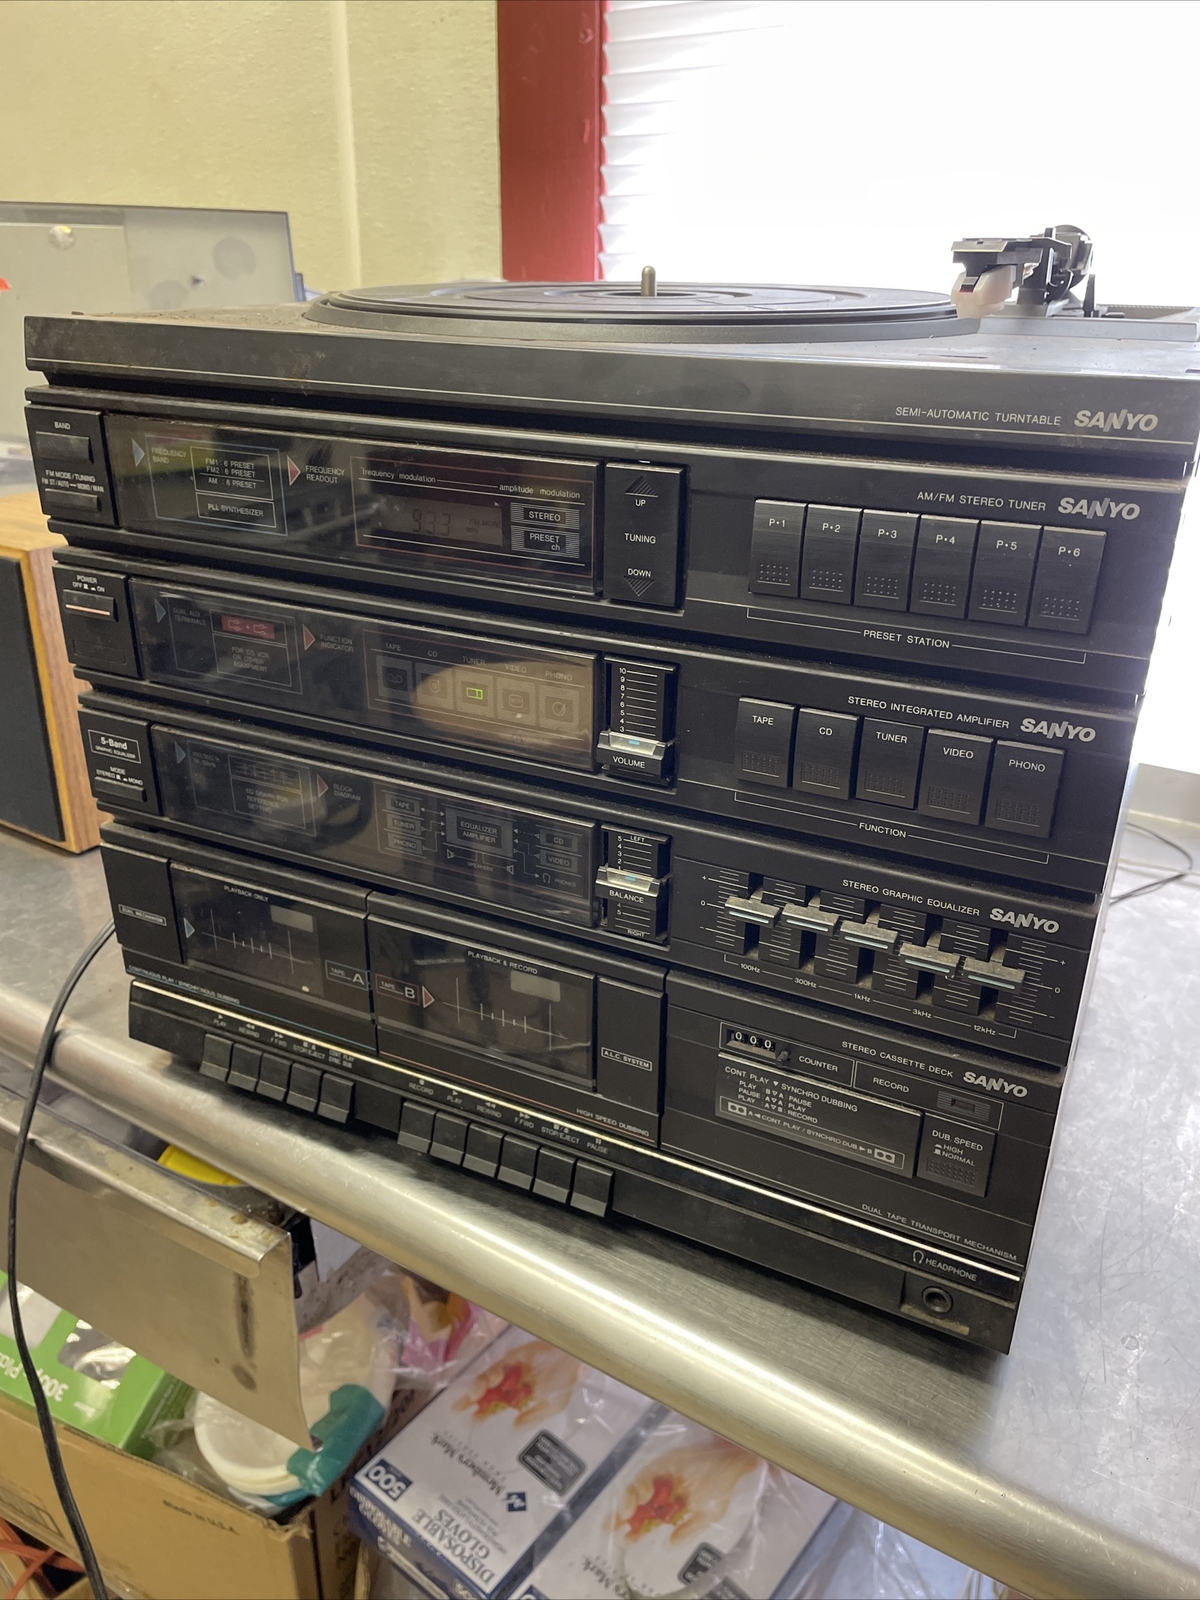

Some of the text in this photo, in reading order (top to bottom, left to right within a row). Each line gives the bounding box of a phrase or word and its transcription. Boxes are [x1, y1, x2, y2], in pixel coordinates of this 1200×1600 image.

[895, 407, 1158, 432] SEMI-AUTOMATIC TURNTABLE SANYO
[54, 422, 71, 430] BAND
[152, 447, 187, 458] FREQUENCY
[230, 461, 255, 470] PRESET
[306, 465, 345, 476] FREQUENCY
[231, 469, 255, 478] PRESET
[306, 474, 338, 484] READOUT
[399, 474, 436, 483] modulation
[233, 480, 256, 489] PRESET
[500, 484, 580, 499] amplitude modulation
[635, 499, 646, 507] UP
[917, 491, 1140, 520] AM/FM STEREO TUNER SANYO
[221, 505, 264, 517] SYNTHESIZER
[529, 511, 561, 521] STEREO
[530, 533, 559, 543] PRESET
[624, 533, 656, 544] TUNING
[551, 543, 560, 551] ch
[628, 568, 651, 577] DOWN
[77, 575, 97, 584] POWER
[320, 634, 353, 644] FUNCTION
[863, 629, 950, 648] PRESET STATION
[321, 641, 354, 652] INDICATOR
[385, 642, 401, 651] TAPE
[428, 650, 438, 658] CD
[462, 656, 486, 666] TUNER
[505, 664, 527, 673] VIDEO
[619, 667, 626, 675] 10
[545, 671, 572, 682] PHONO
[752, 715, 774, 727] TAPE
[848, 696, 1096, 742] STEREO INTEGRATED AMPLIFIER SANYO
[819, 727, 832, 736] CD
[876, 731, 908, 744] TUNER
[100, 736, 128, 751] 5-Band
[943, 747, 974, 759] VIDEO
[612, 756, 645, 768] VOLUME
[1009, 759, 1046, 772] PHONO
[394, 801, 411, 810] TAPE
[392, 820, 415, 830] TUNER
[460, 821, 498, 835] EQUALIZER
[859, 822, 907, 838] FUNCTION
[393, 838, 416, 849] PHONO
[462, 831, 496, 844] AMPLIFIER
[553, 837, 564, 845] CD
[548, 857, 570, 867] VIDEO
[610, 890, 644, 903] BALANCE
[842, 879, 1060, 934] STEREO GRAPHIC EQUALIZER SANYO
[628, 929, 645, 937] RIGHT
[468, 950, 538, 974] PLAYBACK RECORD
[740, 962, 761, 973] 100Hz
[353, 974, 364, 985] A
[794, 977, 817, 988] 300Hz
[404, 987, 415, 999] B
[854, 993, 871, 1002] 1kHz
[912, 1008, 932, 1018] 3kHz
[973, 1023, 996, 1035] 12kHz
[624, 1055, 649, 1069] SYSTEM
[798, 1055, 838, 1072] COUNTER
[841, 1041, 1028, 1098] STEREO CASSETTE DECK SANYO
[408, 1082, 434, 1095] RECORD
[725, 1066, 858, 1112] CONT. PLAY SYNCHRO DUBBING
[873, 1077, 910, 1093] RECORD
[447, 1095, 463, 1104] PLAY
[738, 1087, 807, 1113] PAUSE PLAY
[739, 1080, 812, 1108] PLAY PAUSE
[477, 1104, 502, 1118] REWIND
[737, 1094, 818, 1124] PLAY RECORD
[576, 1107, 649, 1136] HIGH SPEED DUBBING
[541, 1126, 580, 1145] STOP/EJECT
[784, 1120, 801, 1130] PLAY
[806, 1130, 841, 1145] SYNCHRO
[586, 1141, 608, 1154] PAUSE
[943, 1144, 963, 1155] HIGH
[954, 1136, 983, 1151] SPEED
[942, 1151, 975, 1166] NORMAL
[862, 1203, 1017, 1261] DUAL TAPE TRANSPORT MECHANISM
[925, 1257, 977, 1281] HEADPHONE
[368, 1465, 407, 1499] 500
[436, 1509, 490, 1559] GLOVES
[411, 1508, 495, 1584] DISPOSABLE
